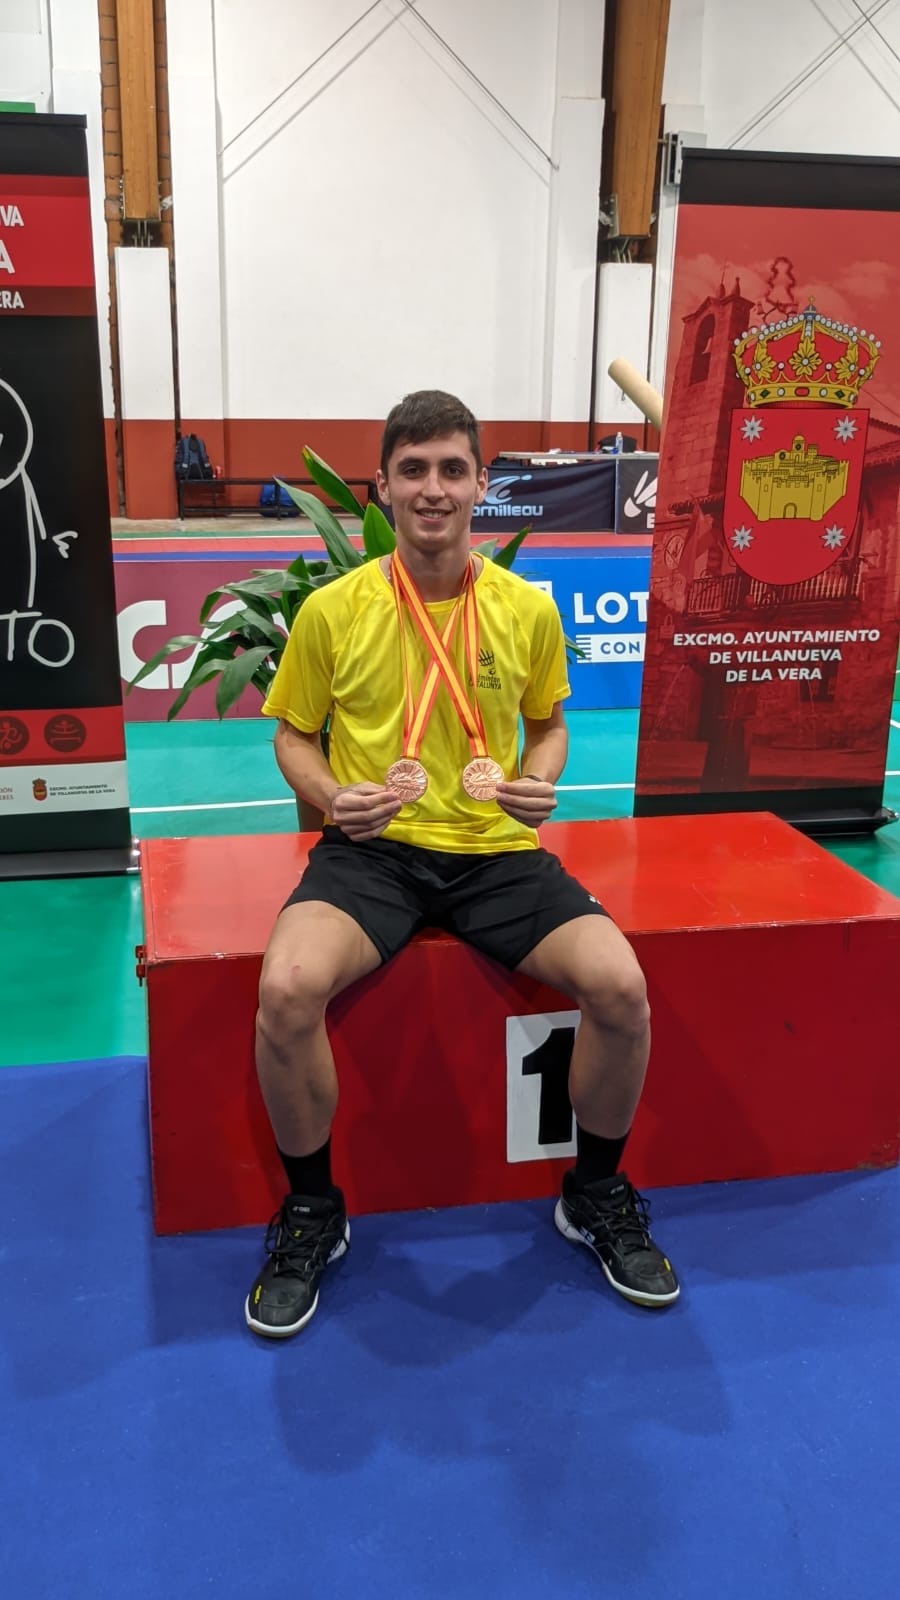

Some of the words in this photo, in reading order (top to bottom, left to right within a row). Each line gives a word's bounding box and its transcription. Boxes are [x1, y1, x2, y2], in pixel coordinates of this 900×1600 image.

[573, 591, 649, 624] LOT
[673, 633, 738, 646] EXCMO.
[743, 629, 880, 645] AYUNTAMIENTO
[600, 641, 641, 655] CON
[709, 651, 731, 664] DE
[736, 649, 842, 663] VILLANUEVA
[726, 669, 748, 683] DE
[751, 668, 773, 682] LA
[778, 667, 823, 681] VERA
[522, 1027, 575, 1145] 1
